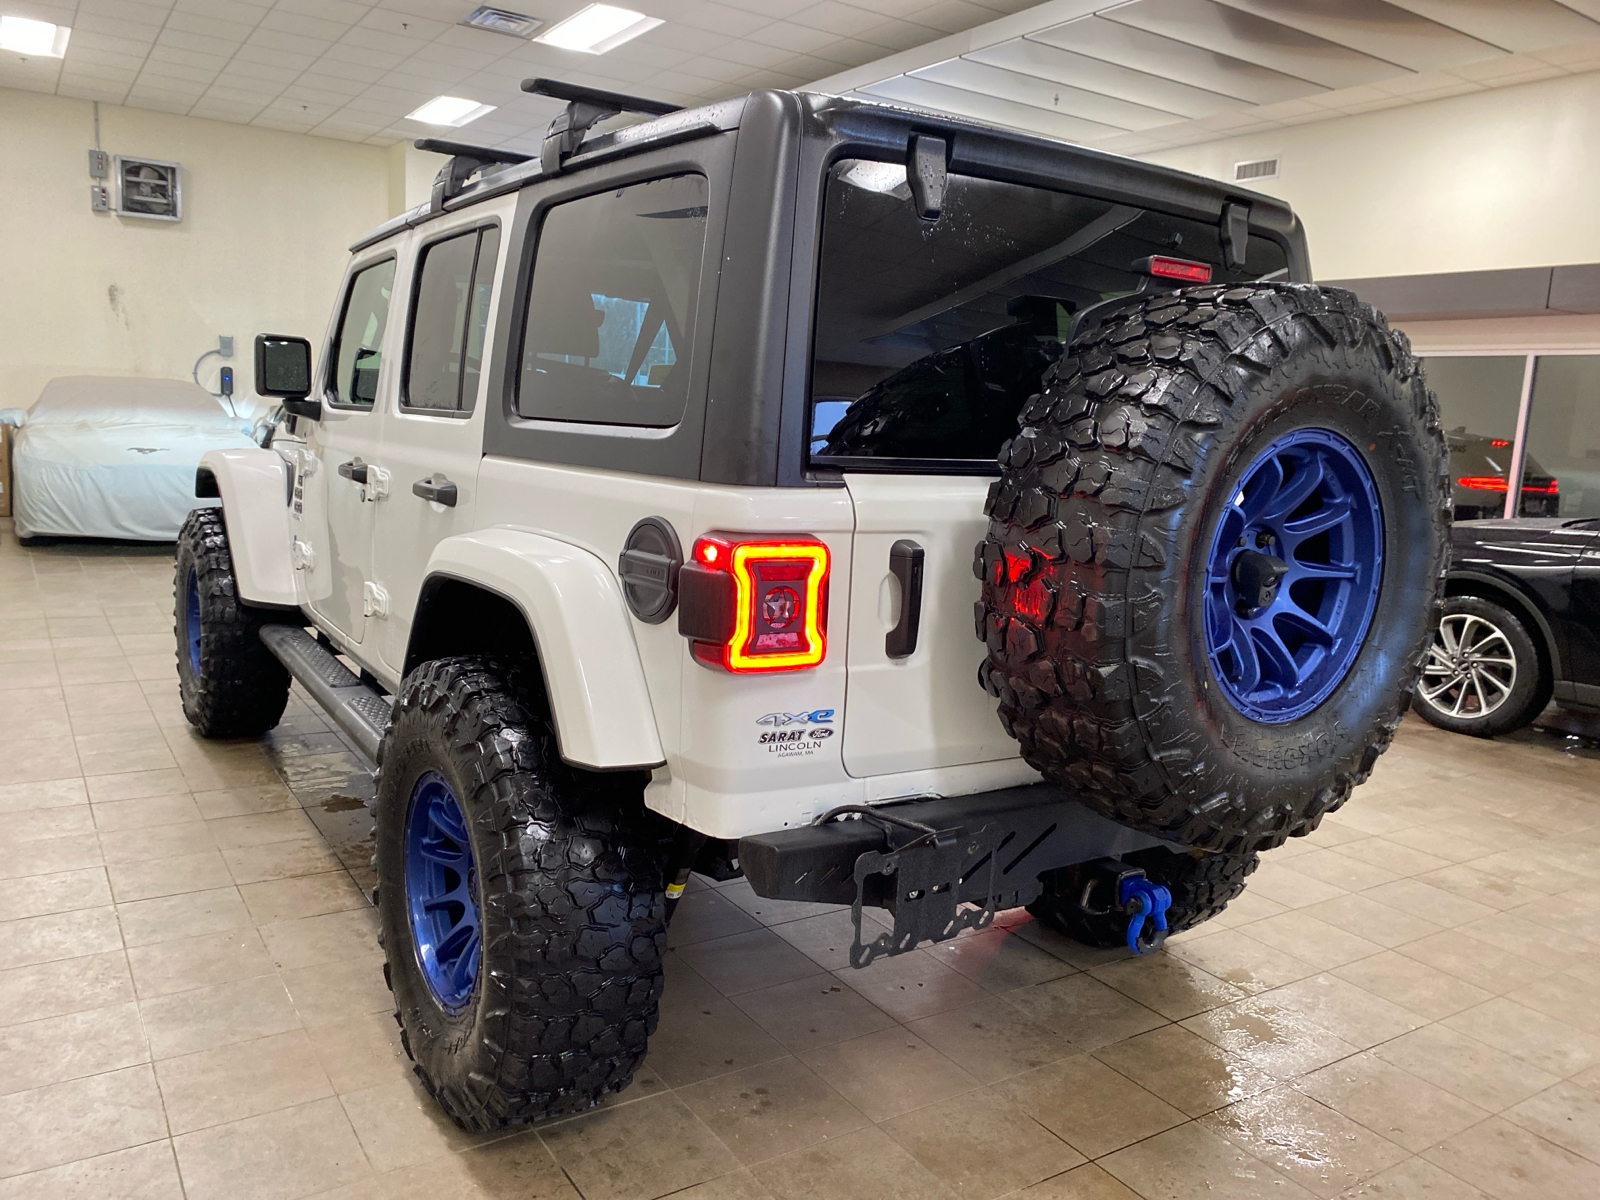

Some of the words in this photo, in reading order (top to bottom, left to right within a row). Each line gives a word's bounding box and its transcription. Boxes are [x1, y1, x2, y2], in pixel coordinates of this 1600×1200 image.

[758, 729, 806, 744] SARAT
[810, 728, 833, 739] Ford
[768, 741, 822, 752] LINCOLN
